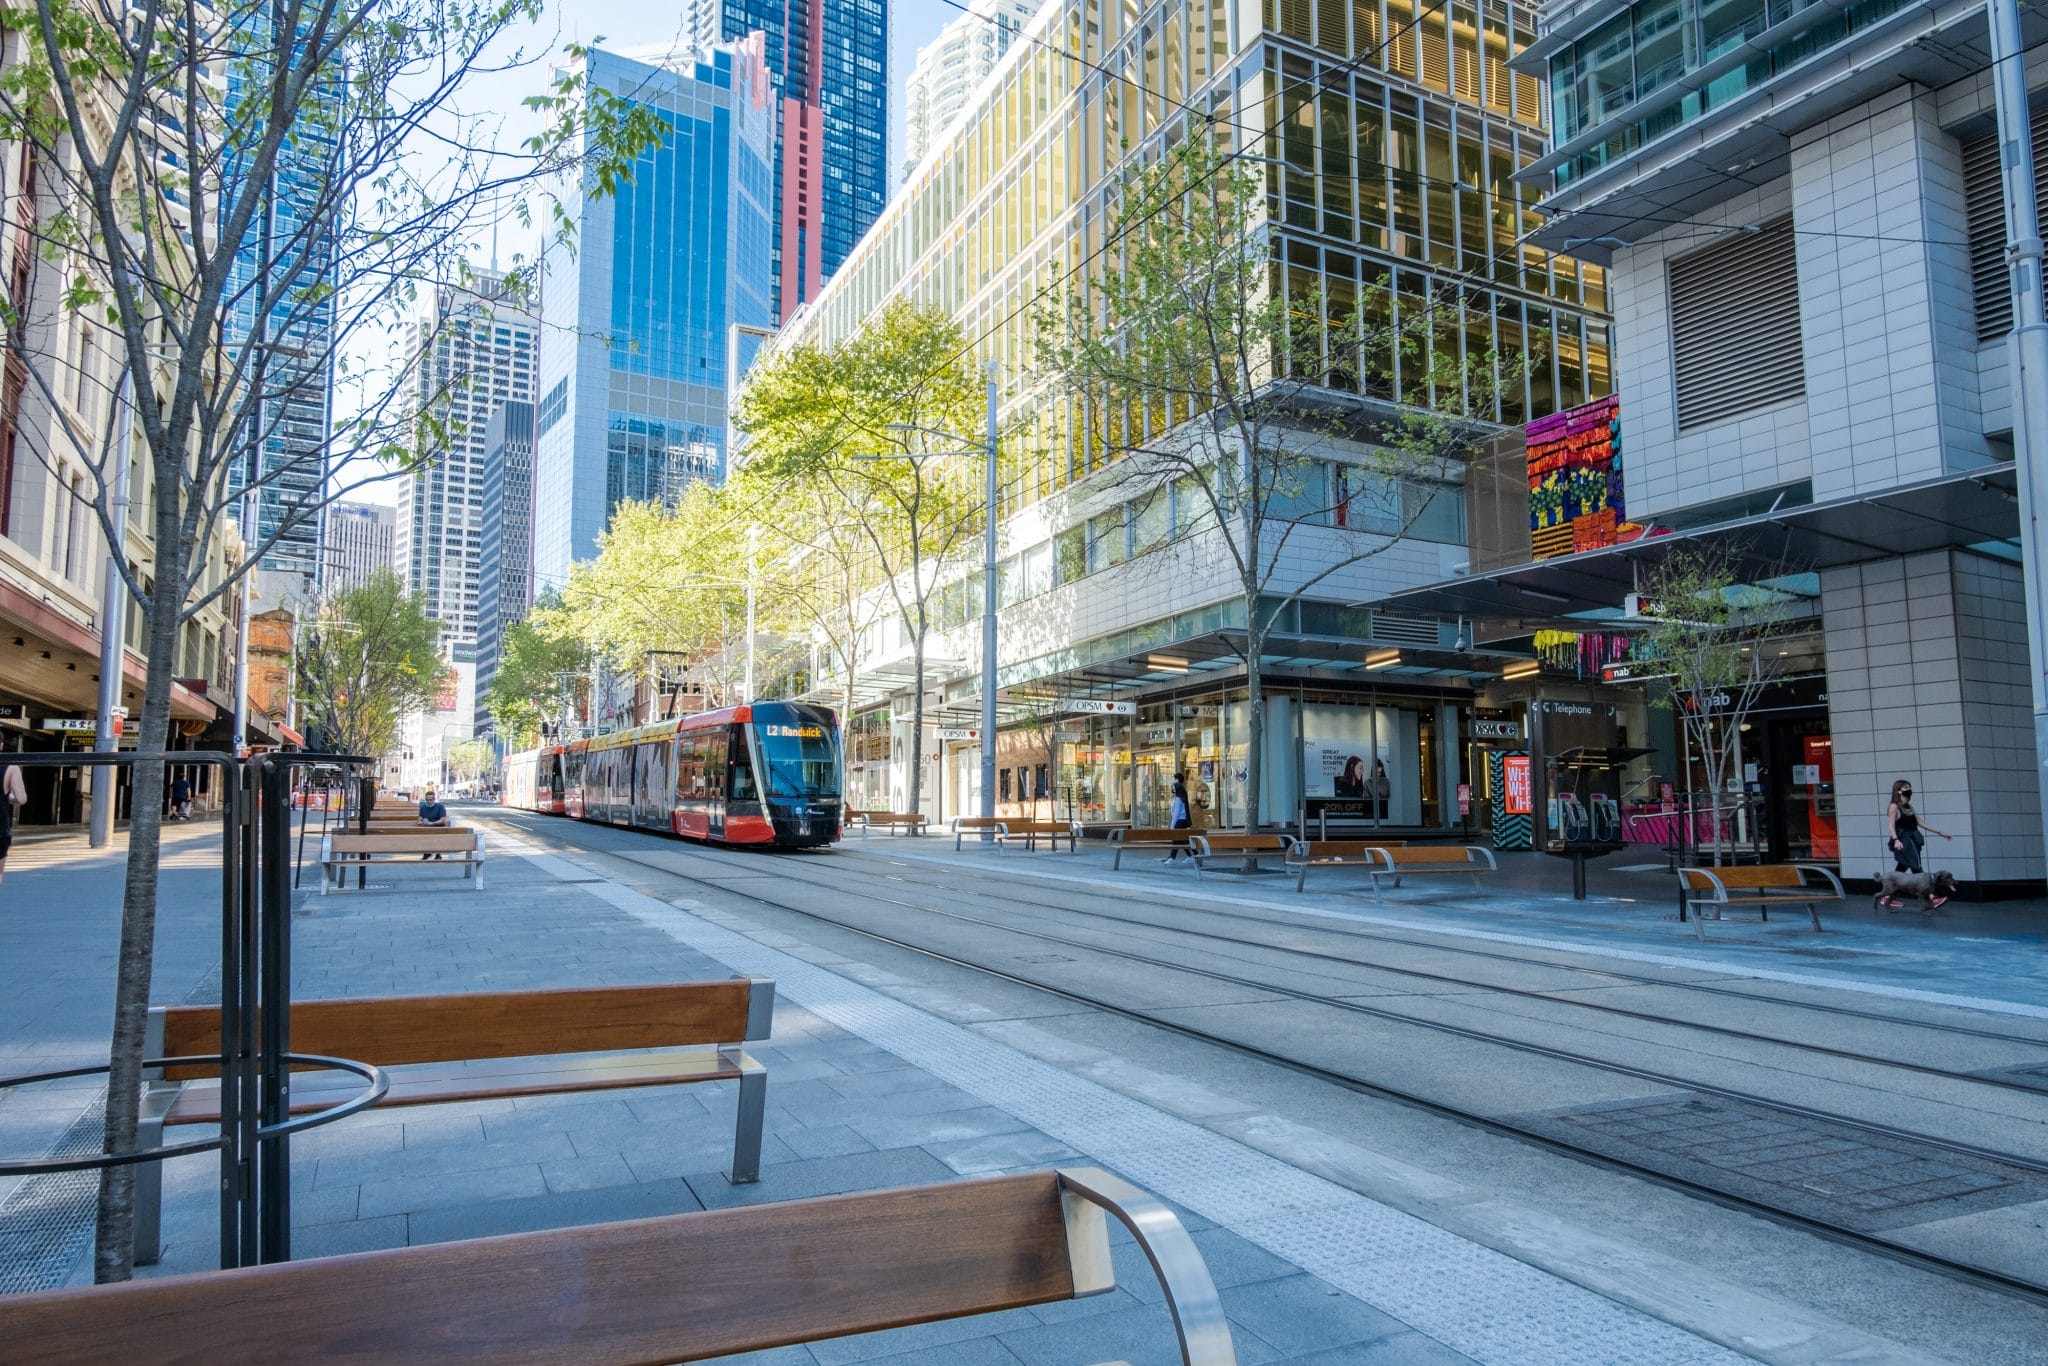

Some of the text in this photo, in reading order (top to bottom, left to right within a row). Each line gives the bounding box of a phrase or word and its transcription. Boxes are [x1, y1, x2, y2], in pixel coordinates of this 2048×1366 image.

[1613, 668, 1630, 677] nab
[1076, 701, 1102, 711] OPSM
[1703, 692, 1731, 706] nab
[1553, 702, 1592, 716] Telephone
[766, 724, 821, 738] L2 Randwick
[944, 730, 967, 738] OPSM
[1507, 766, 1530, 782] Wi-F
[1508, 781, 1531, 796] Wi-F
[1325, 803, 1364, 812] 20% OFF
[1510, 795, 1531, 811] Wi-F
